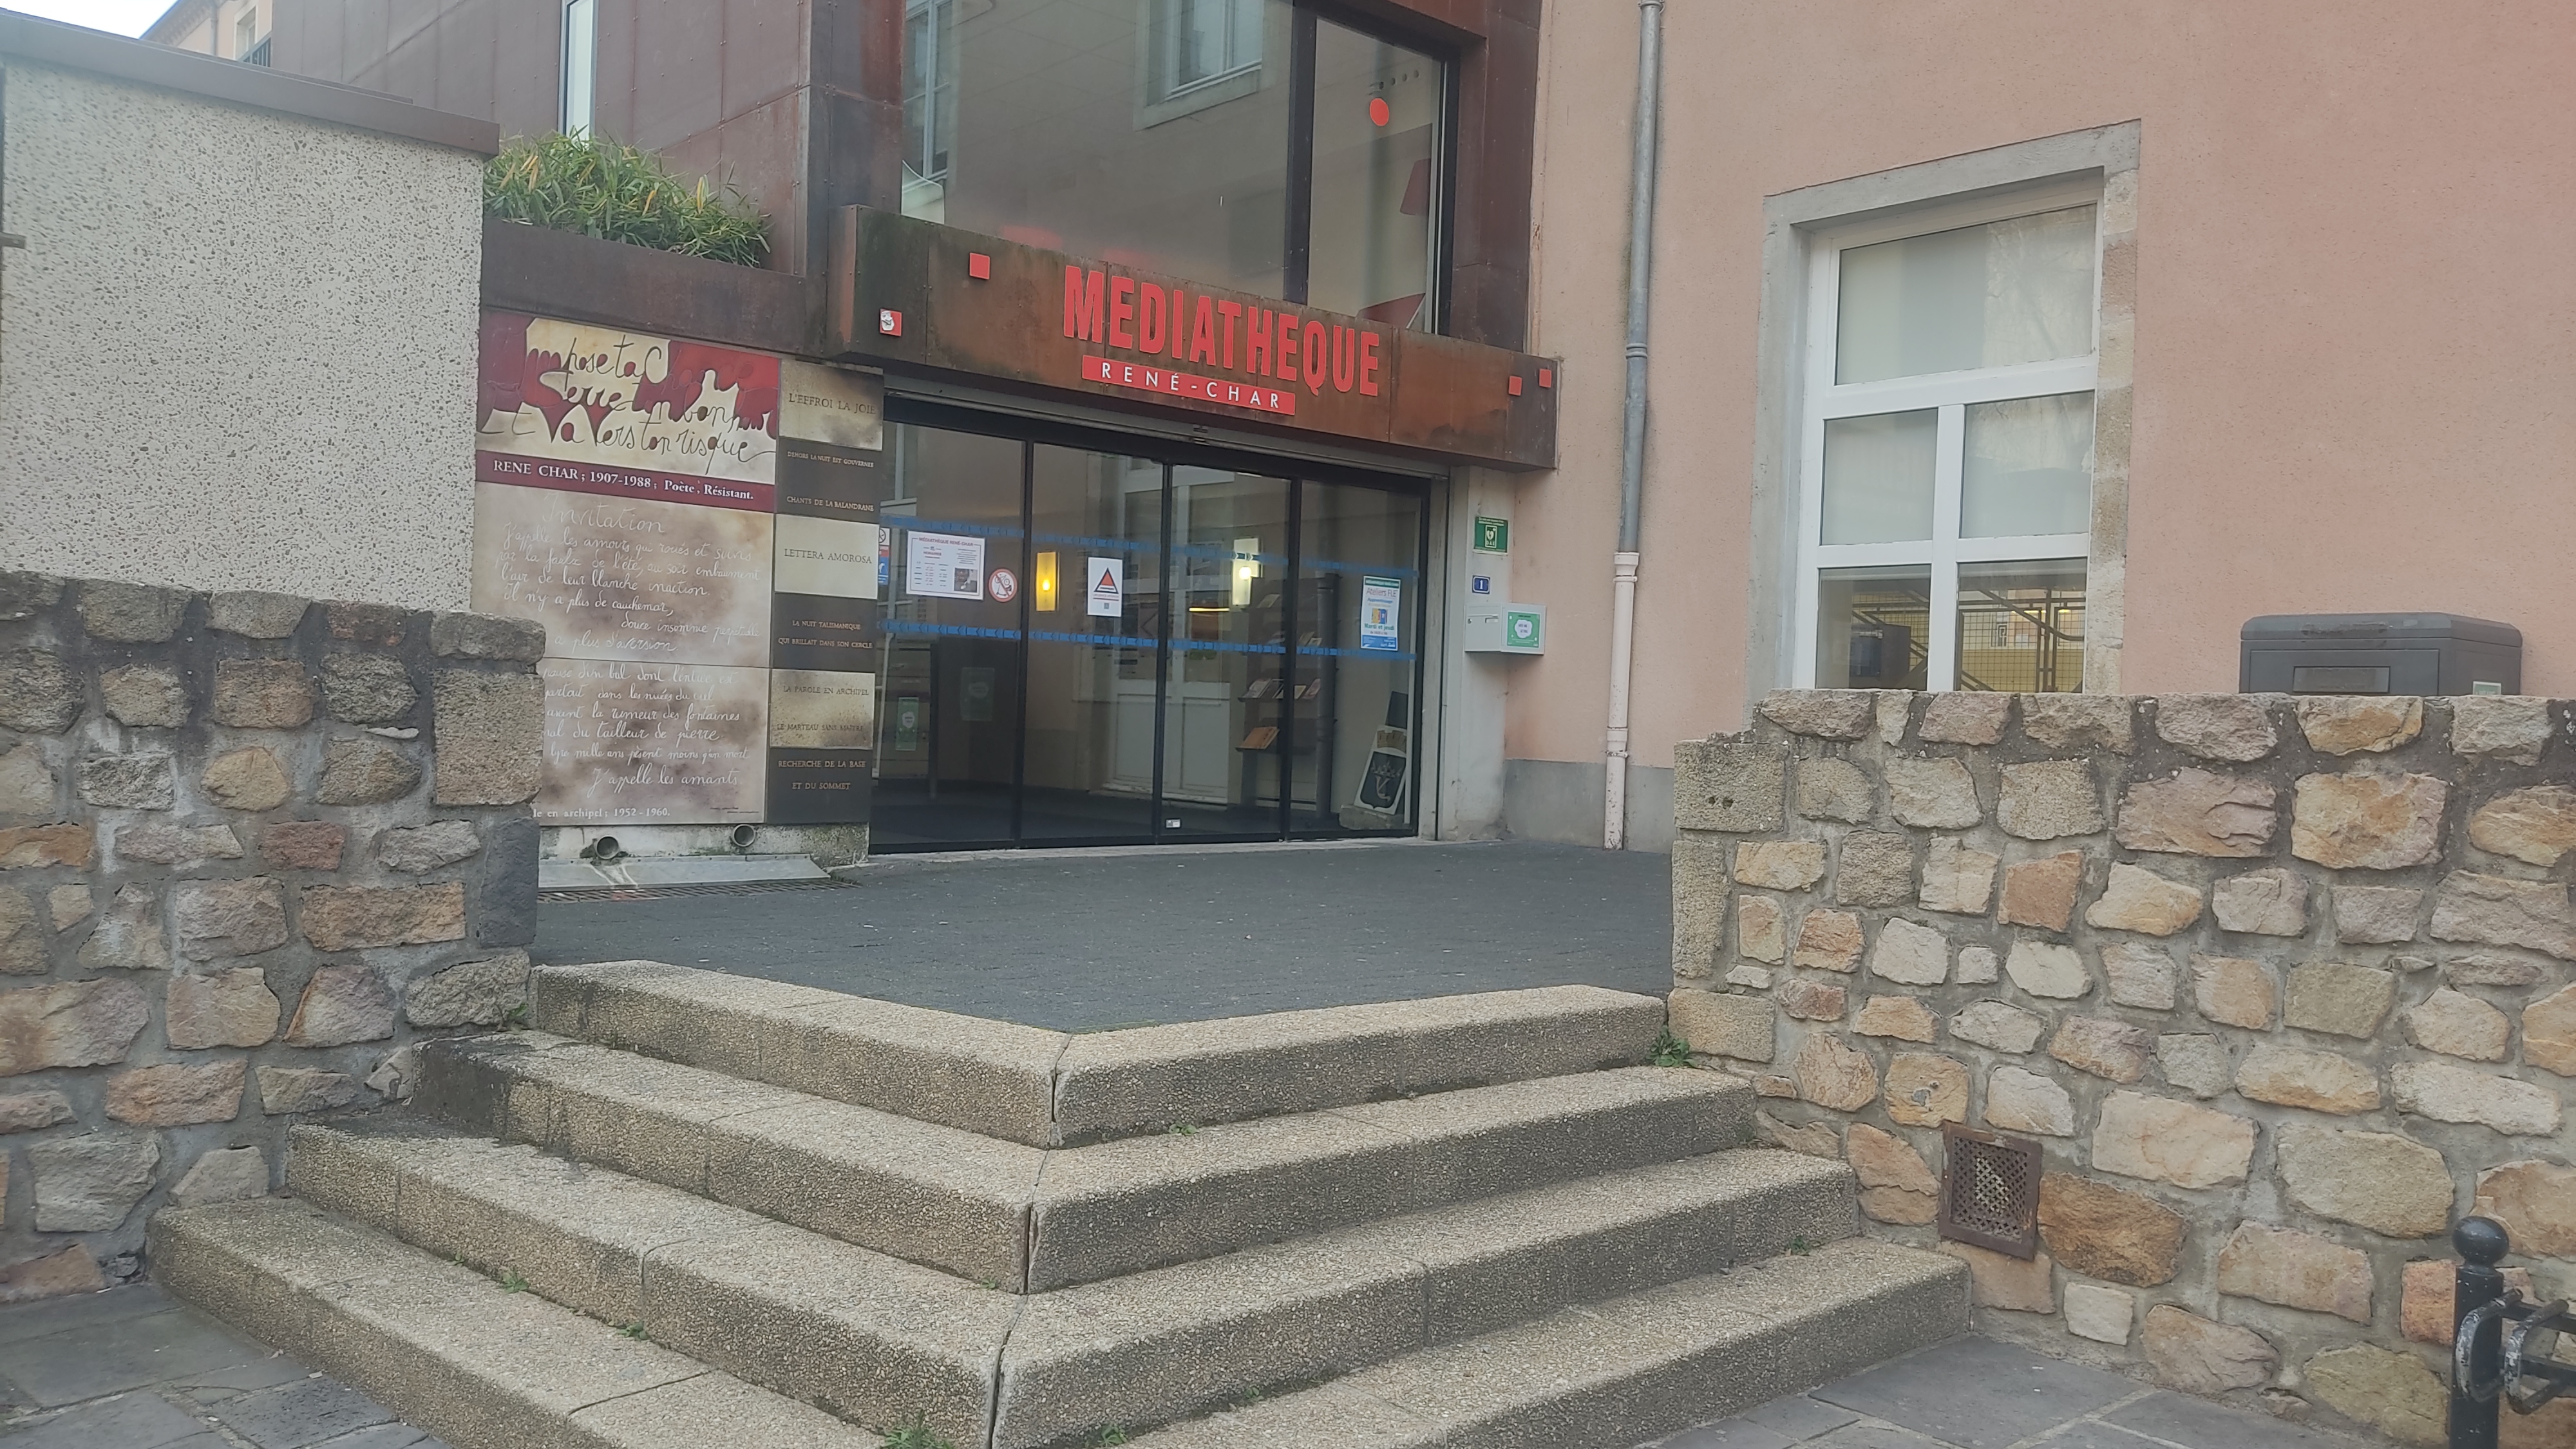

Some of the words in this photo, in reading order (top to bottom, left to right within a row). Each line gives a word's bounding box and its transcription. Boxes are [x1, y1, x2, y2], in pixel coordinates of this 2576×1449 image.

[1063, 264, 1379, 397] MEDIATHEQUE
[1101, 361, 1279, 410] RENÉ-CHAR
[789, 393, 833, 408] L'EFFROI
[838, 401, 851, 411] LA
[854, 403, 876, 414] JOIE
[493, 460, 533, 475] RENE
[703, 484, 754, 500] Résistant.
[542, 491, 665, 533] Invitation
[786, 496, 812, 505] CHANTS
[834, 501, 875, 512] BALANDRANE
[502, 522, 553, 552] J'appelle
[559, 526, 578, 547] les
[583, 538, 630, 553] amours
[635, 542, 654, 561] qui
[694, 542, 711, 557] et
[714, 548, 753, 562] suivis
[495, 551, 517, 569] par
[524, 544, 540, 562] la
[591, 548, 606, 568] de
[784, 549, 824, 560] LETTERA
[828, 553, 873, 564] AMOROSA
[538, 565, 554, 584] de
[561, 565, 587, 586] leur
[554, 595, 565, 605] a
[566, 588, 589, 614] plus
[594, 589, 607, 608] de
[620, 610, 652, 631] douce
[657, 619, 709, 633] insomnie
[818, 621, 862, 631] TALISMANIQUE
[571, 629, 600, 654] plus
[791, 638, 817, 647] BRILLAIT
[637, 664, 668, 682] dont
[598, 683, 622, 699] dans
[629, 682, 641, 699] les
[675, 687, 690, 701] du
[591, 699, 604, 719] la
[611, 707, 658, 721] rumeur
[662, 703, 680, 721] des
[683, 702, 741, 732] fontaines
[573, 720, 591, 739] du
[596, 719, 650, 739] tailleur
[654, 721, 667, 739] de
[573, 742, 605, 759] mille
[607, 750, 624, 759] ans
[658, 764, 674, 785] les
